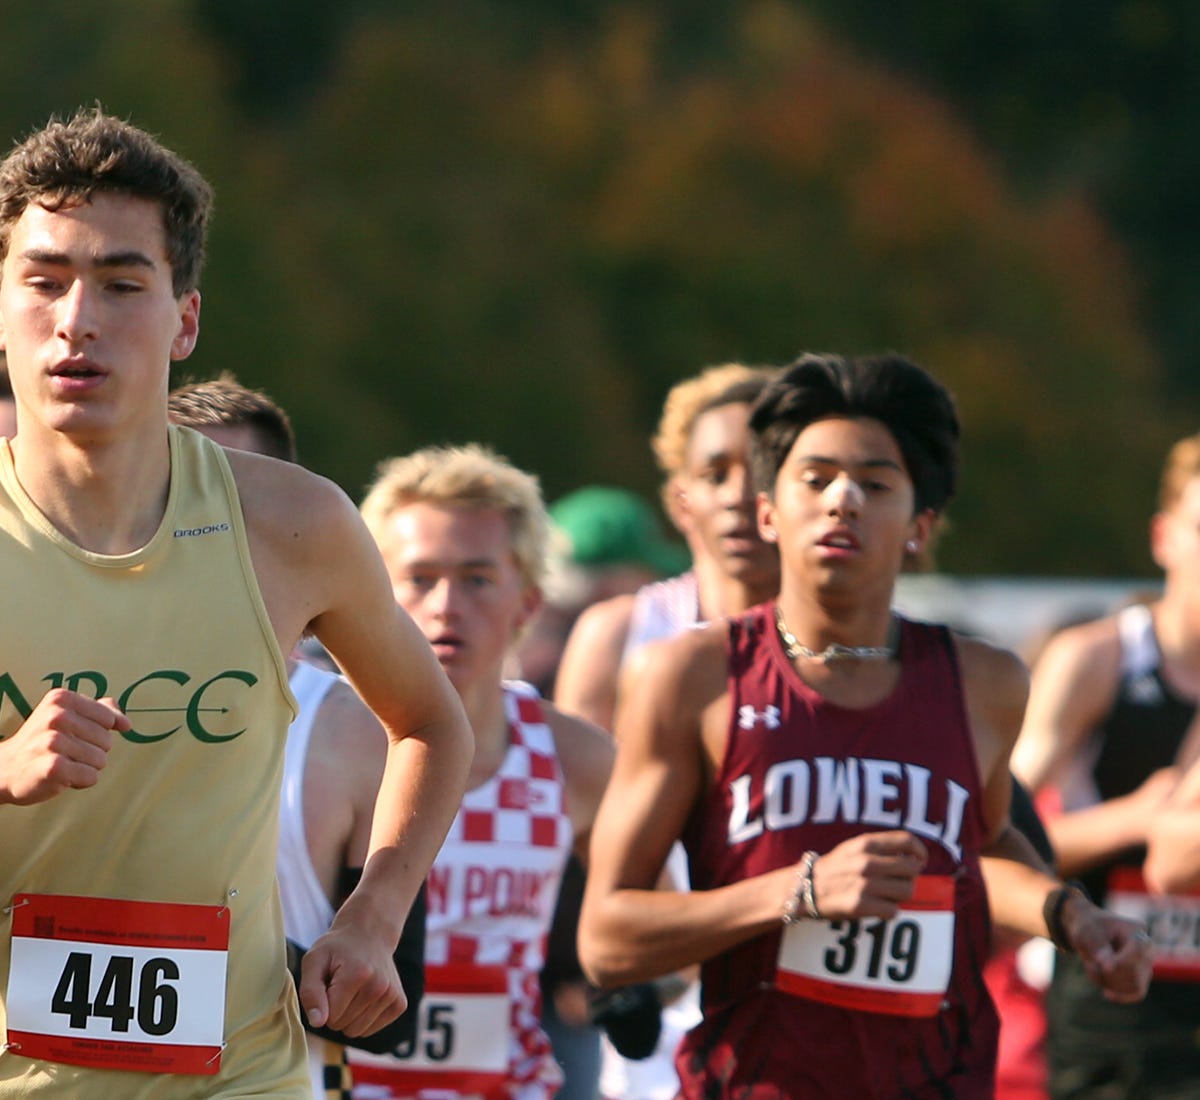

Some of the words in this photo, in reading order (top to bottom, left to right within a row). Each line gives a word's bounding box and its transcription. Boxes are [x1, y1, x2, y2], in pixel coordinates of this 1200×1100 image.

[174, 523, 229, 537] BROOKS
[824, 918, 922, 982] 319
[51, 952, 180, 1037] 446
